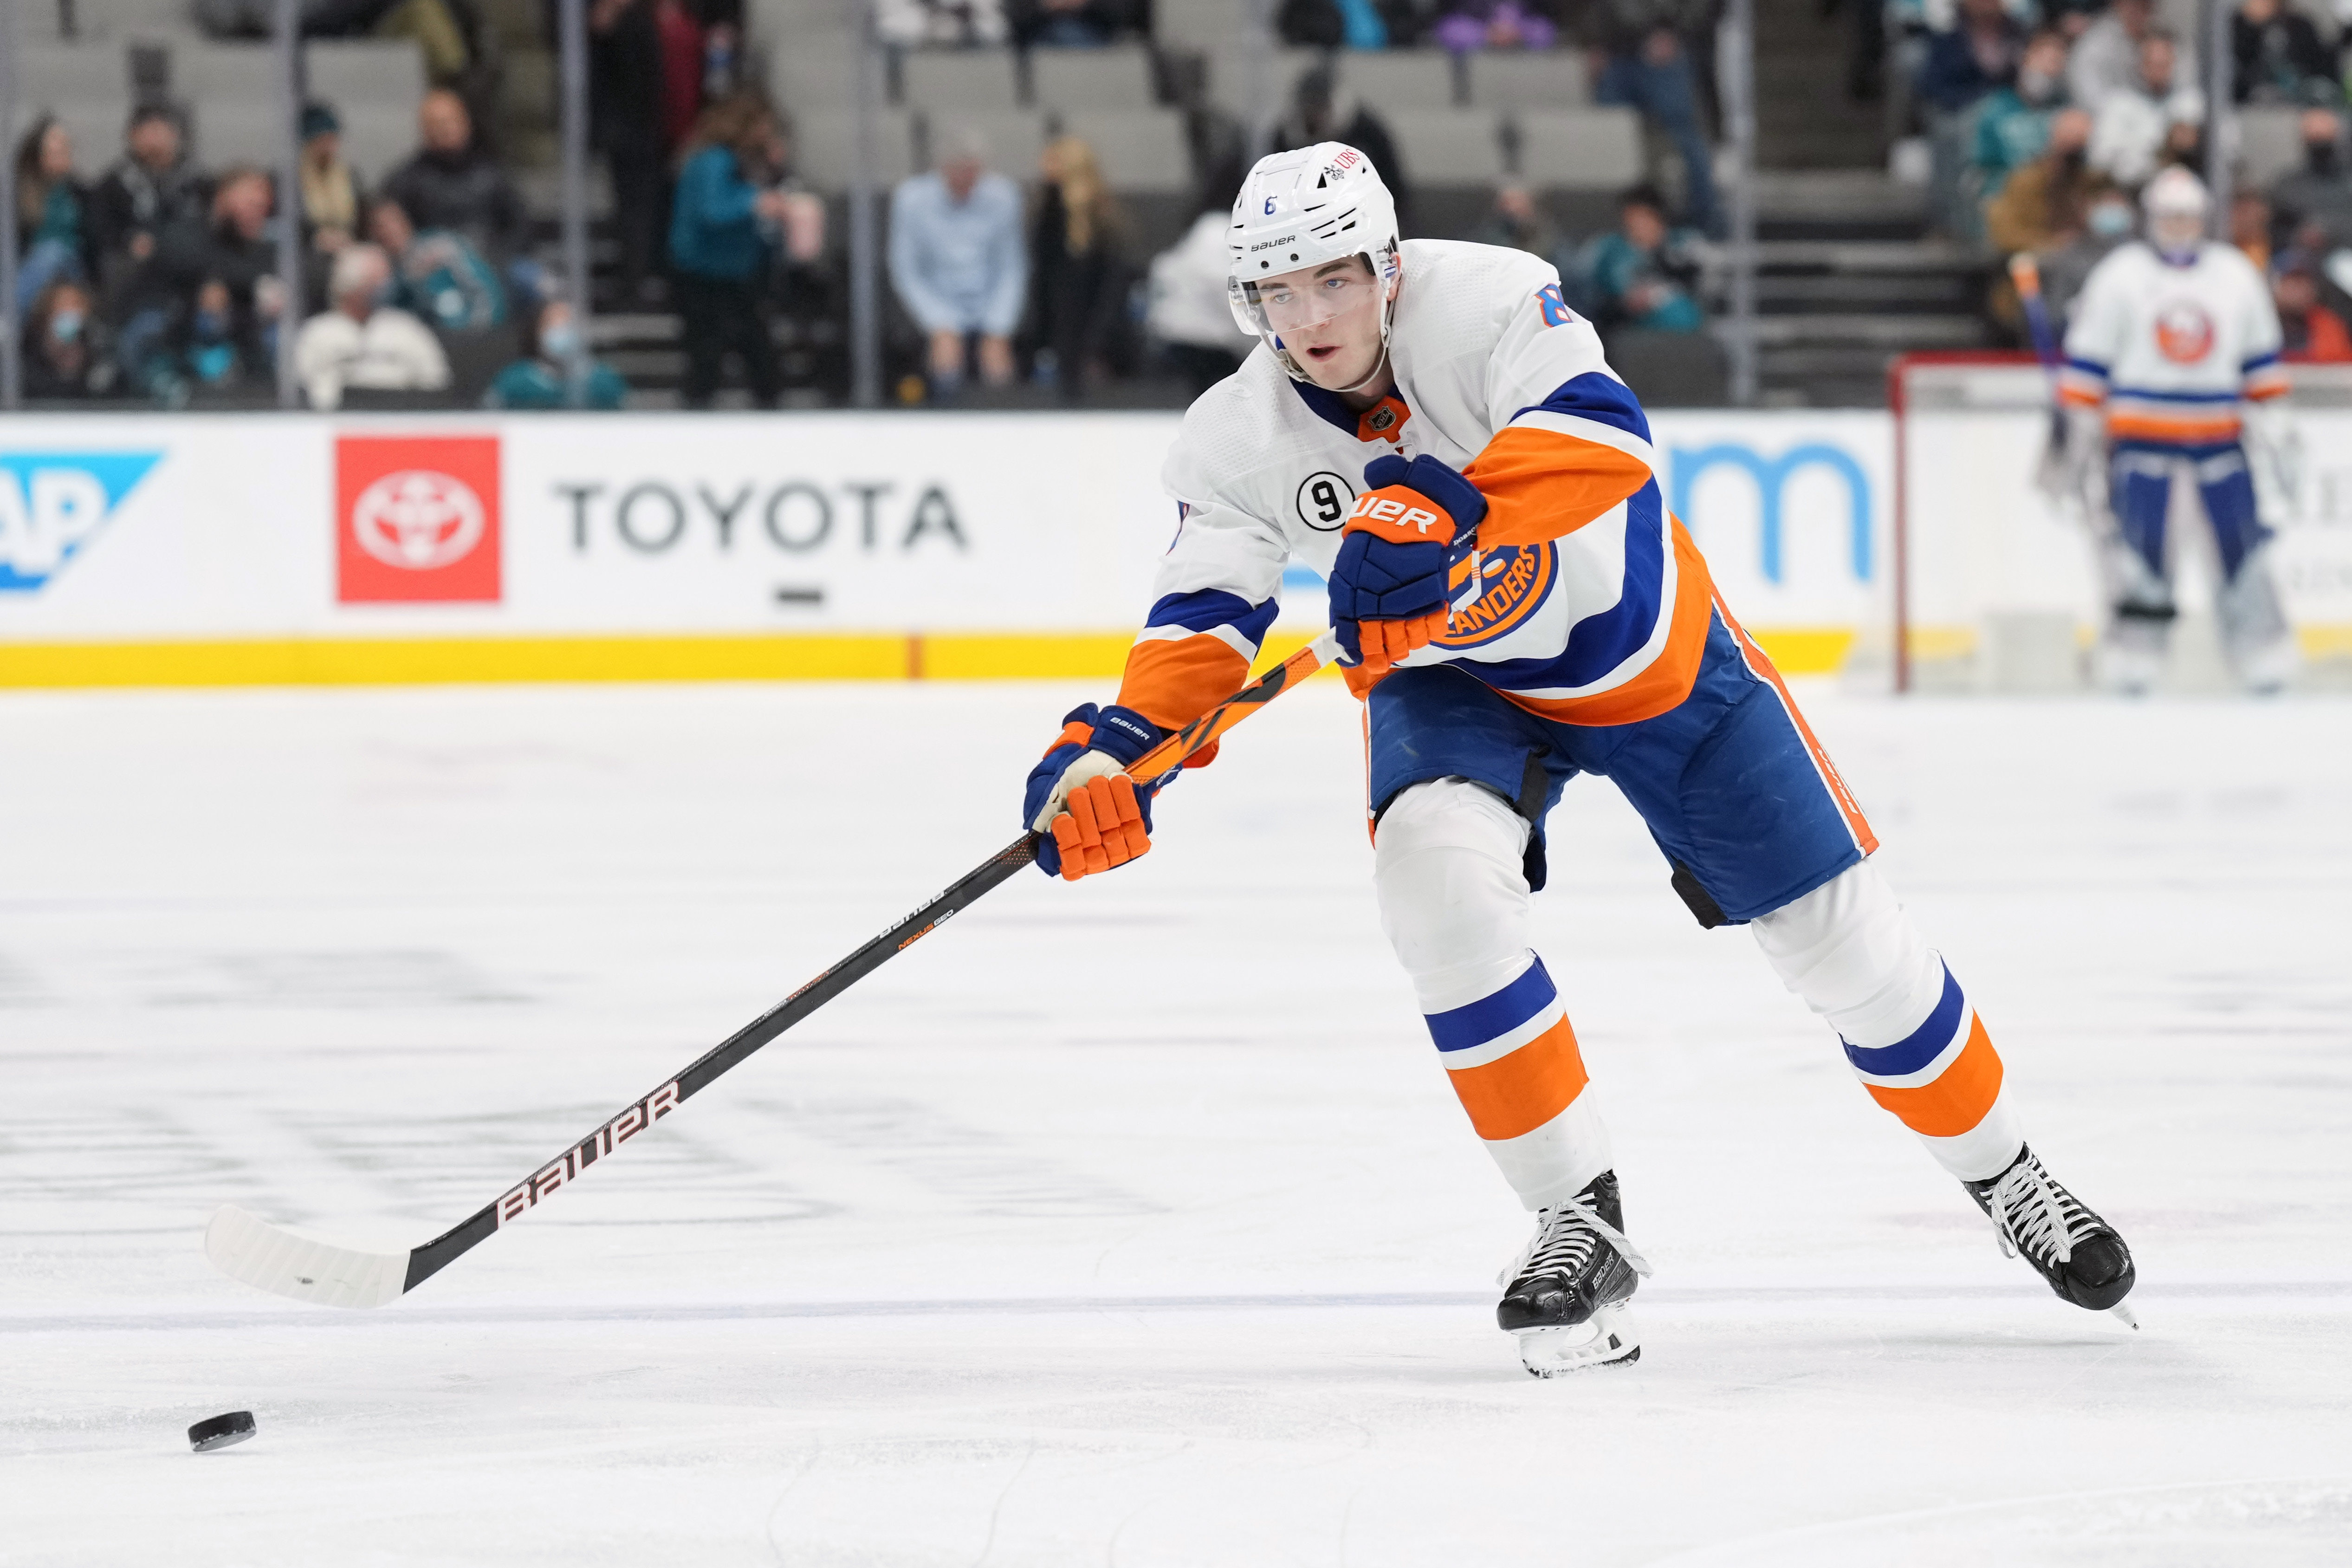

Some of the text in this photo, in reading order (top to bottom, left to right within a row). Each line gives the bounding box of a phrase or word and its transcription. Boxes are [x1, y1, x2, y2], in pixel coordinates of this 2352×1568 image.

[1334, 149, 1360, 168] UBS
[1251, 235, 1296, 252] BAUER
[553, 482, 968, 553] TOYOTA
[1311, 480, 1341, 522] 9
[1449, 545, 1535, 635] ANDERS
[1110, 717, 1150, 740] BAUER
[497, 1080, 680, 1230] BAUER
[1592, 1251, 1614, 1290] BAUER
